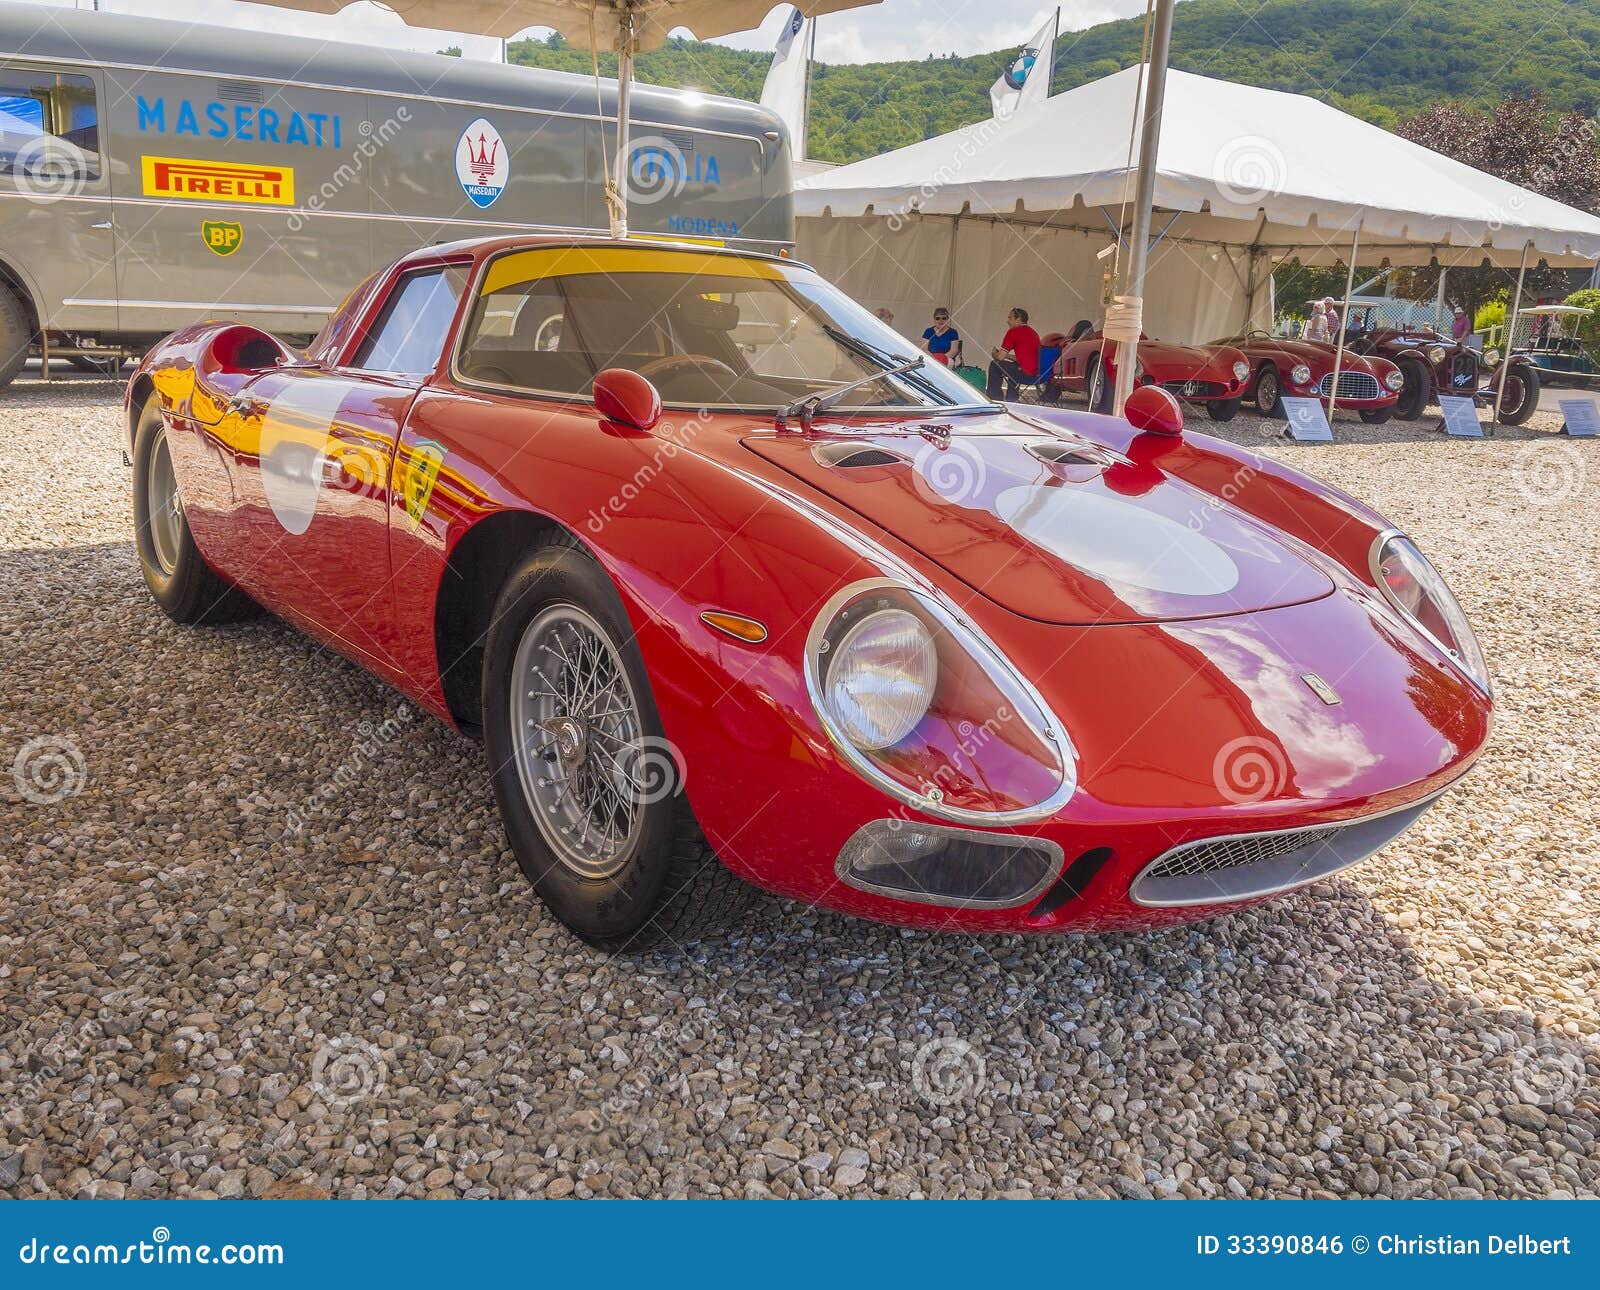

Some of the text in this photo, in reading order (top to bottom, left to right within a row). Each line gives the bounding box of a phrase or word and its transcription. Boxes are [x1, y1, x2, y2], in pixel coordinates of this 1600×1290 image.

[137, 95, 341, 149] MASERATI
[154, 162, 282, 199] PIRELLI
[632, 147, 720, 185] ITALIA
[468, 186, 498, 197] MASERATI
[209, 227, 239, 247] BP
[667, 214, 739, 236] MODENA
